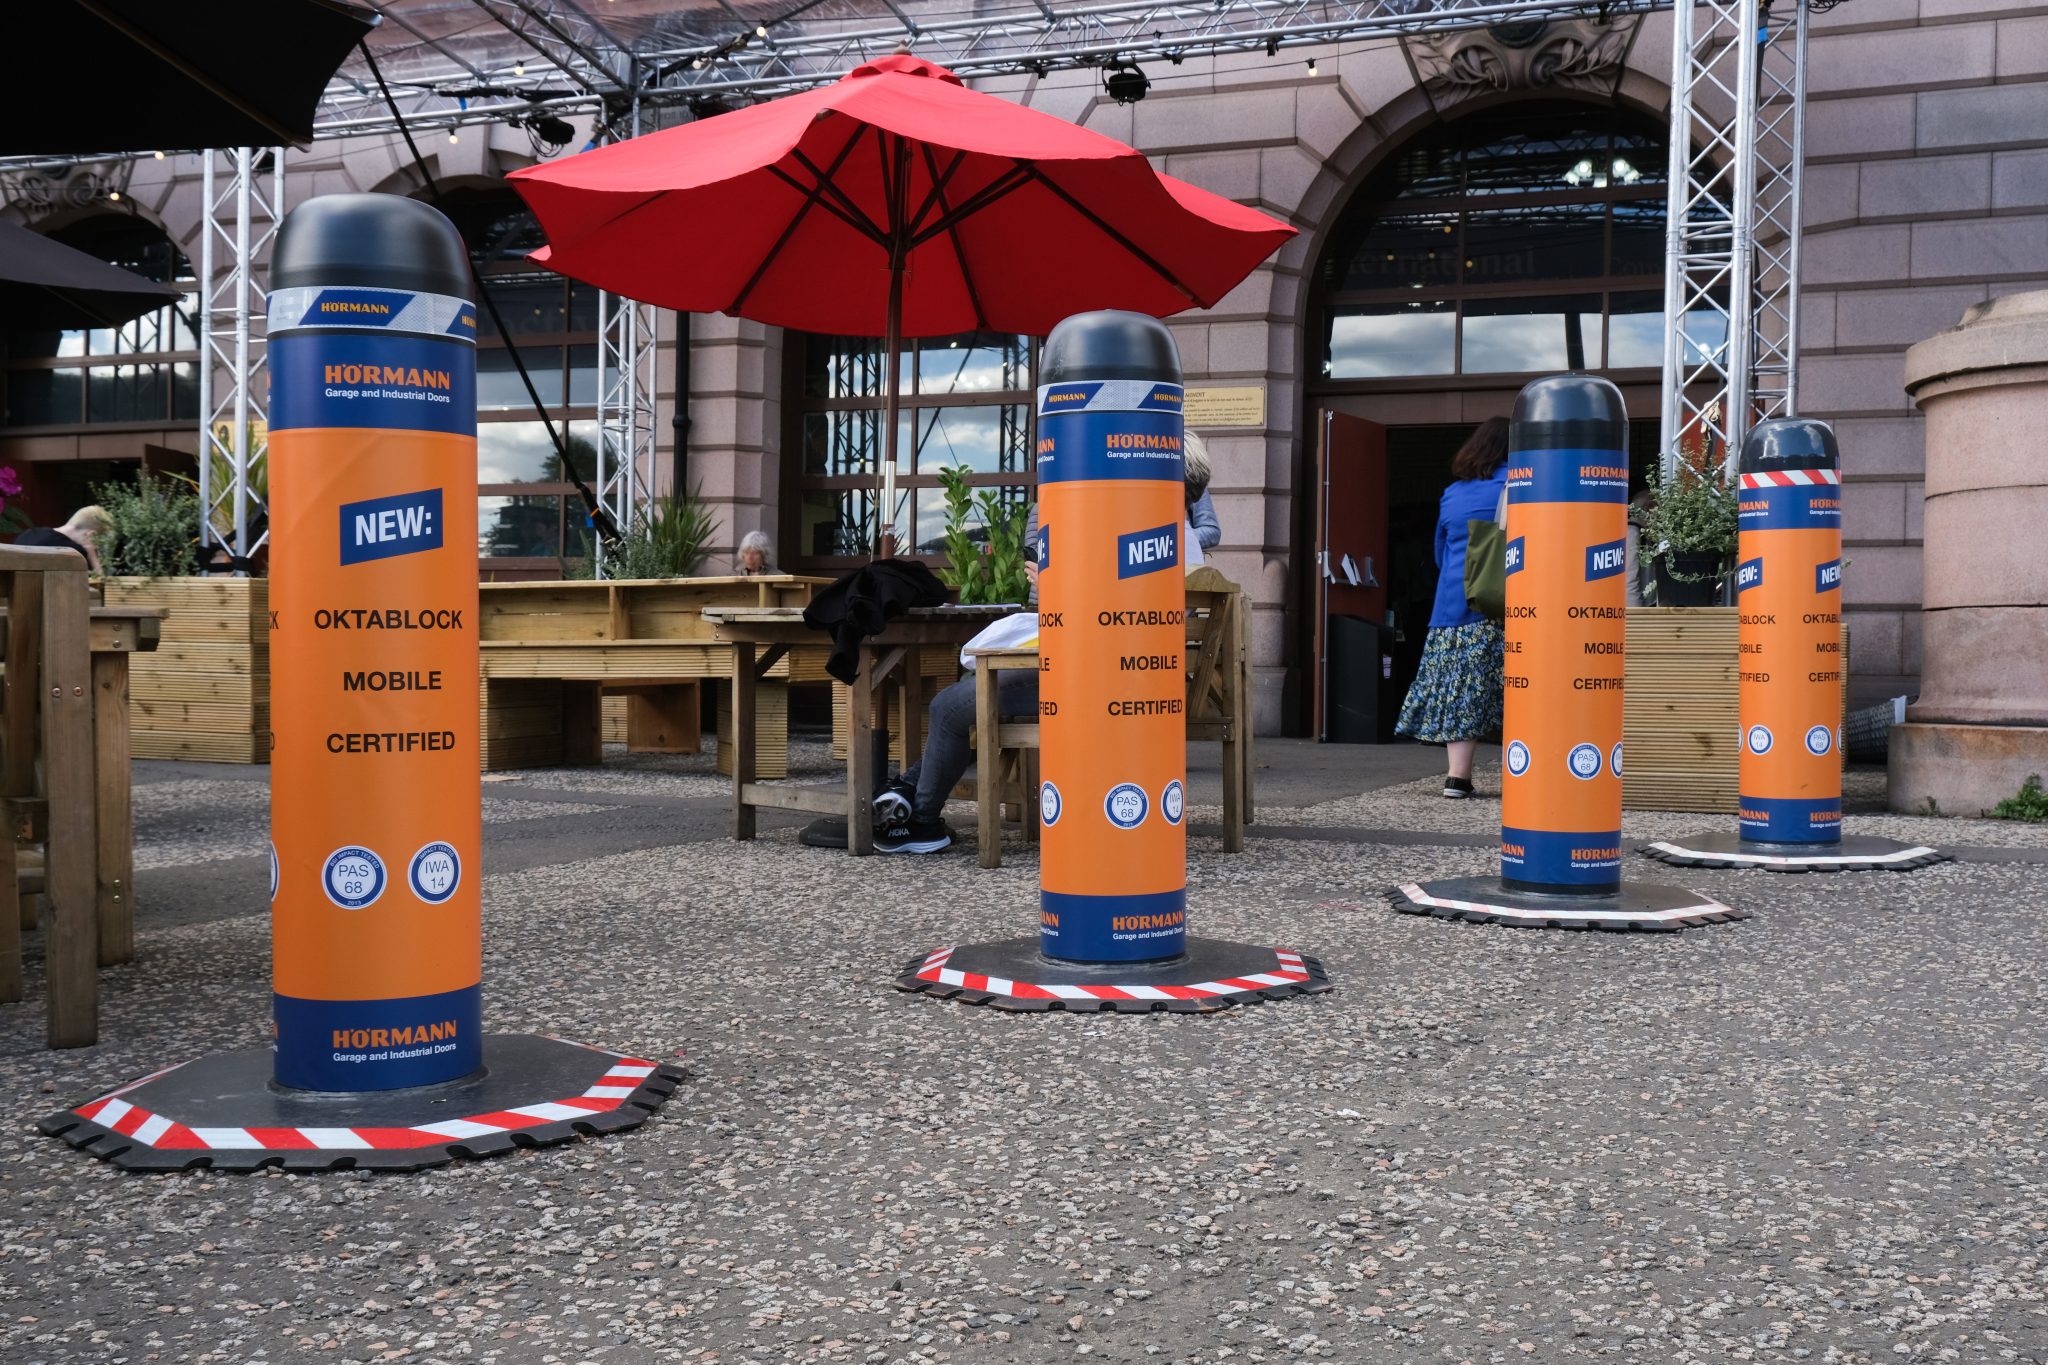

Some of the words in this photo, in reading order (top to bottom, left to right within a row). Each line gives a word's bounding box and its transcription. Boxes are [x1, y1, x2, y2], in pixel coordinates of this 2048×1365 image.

[321, 301, 389, 314] HÖRMANN
[325, 364, 450, 390] HÖRMANN
[325, 388, 359, 399] Garage
[361, 389, 380, 398] and
[382, 389, 426, 401] Industrial
[427, 392, 450, 403] Doors
[1106, 433, 1181, 450] HÖRMANN
[1107, 451, 1131, 460] Garage
[355, 505, 432, 546] NEW:
[1128, 535, 1173, 565] NEW:
[1505, 546, 1520, 569] EW:
[1593, 547, 1624, 571] NEW:
[1821, 566, 1840, 585] NEW
[314, 609, 463, 629] OKTABLOCK
[1098, 611, 1185, 626] OKTABLOCK
[1505, 641, 1522, 653] BILE
[1584, 642, 1623, 654] MOBILE
[1739, 643, 1762, 654] OBILE
[1120, 655, 1177, 671] MOBILE
[343, 671, 442, 691] MOBILE
[1573, 678, 1624, 690] CERTIFIE
[1108, 699, 1183, 716] CERTIFIED
[326, 731, 455, 753] CERTIFIED
[1577, 754, 1594, 762] PAS
[1117, 797, 1138, 806] PAS
[1121, 809, 1133, 818] 68
[888, 828, 910, 837] HOKA
[338, 850, 359, 860] IMPACT
[361, 852, 380, 869] TESTED
[419, 846, 437, 860] IMPACT
[438, 846, 455, 858] TESTED
[338, 864, 369, 877] PAS
[425, 860, 449, 874] IWA
[344, 882, 362, 894] 68
[431, 877, 444, 889] 14
[1112, 910, 1183, 930] HÖRMANN
[1113, 933, 1137, 941] Garage
[1151, 928, 1174, 938] Industrial
[333, 1019, 457, 1049] HÖRMANN
[333, 1052, 367, 1063] Garage
[369, 1051, 387, 1061] and
[390, 1046, 433, 1059] Industrial
[435, 1042, 457, 1053] Doors
